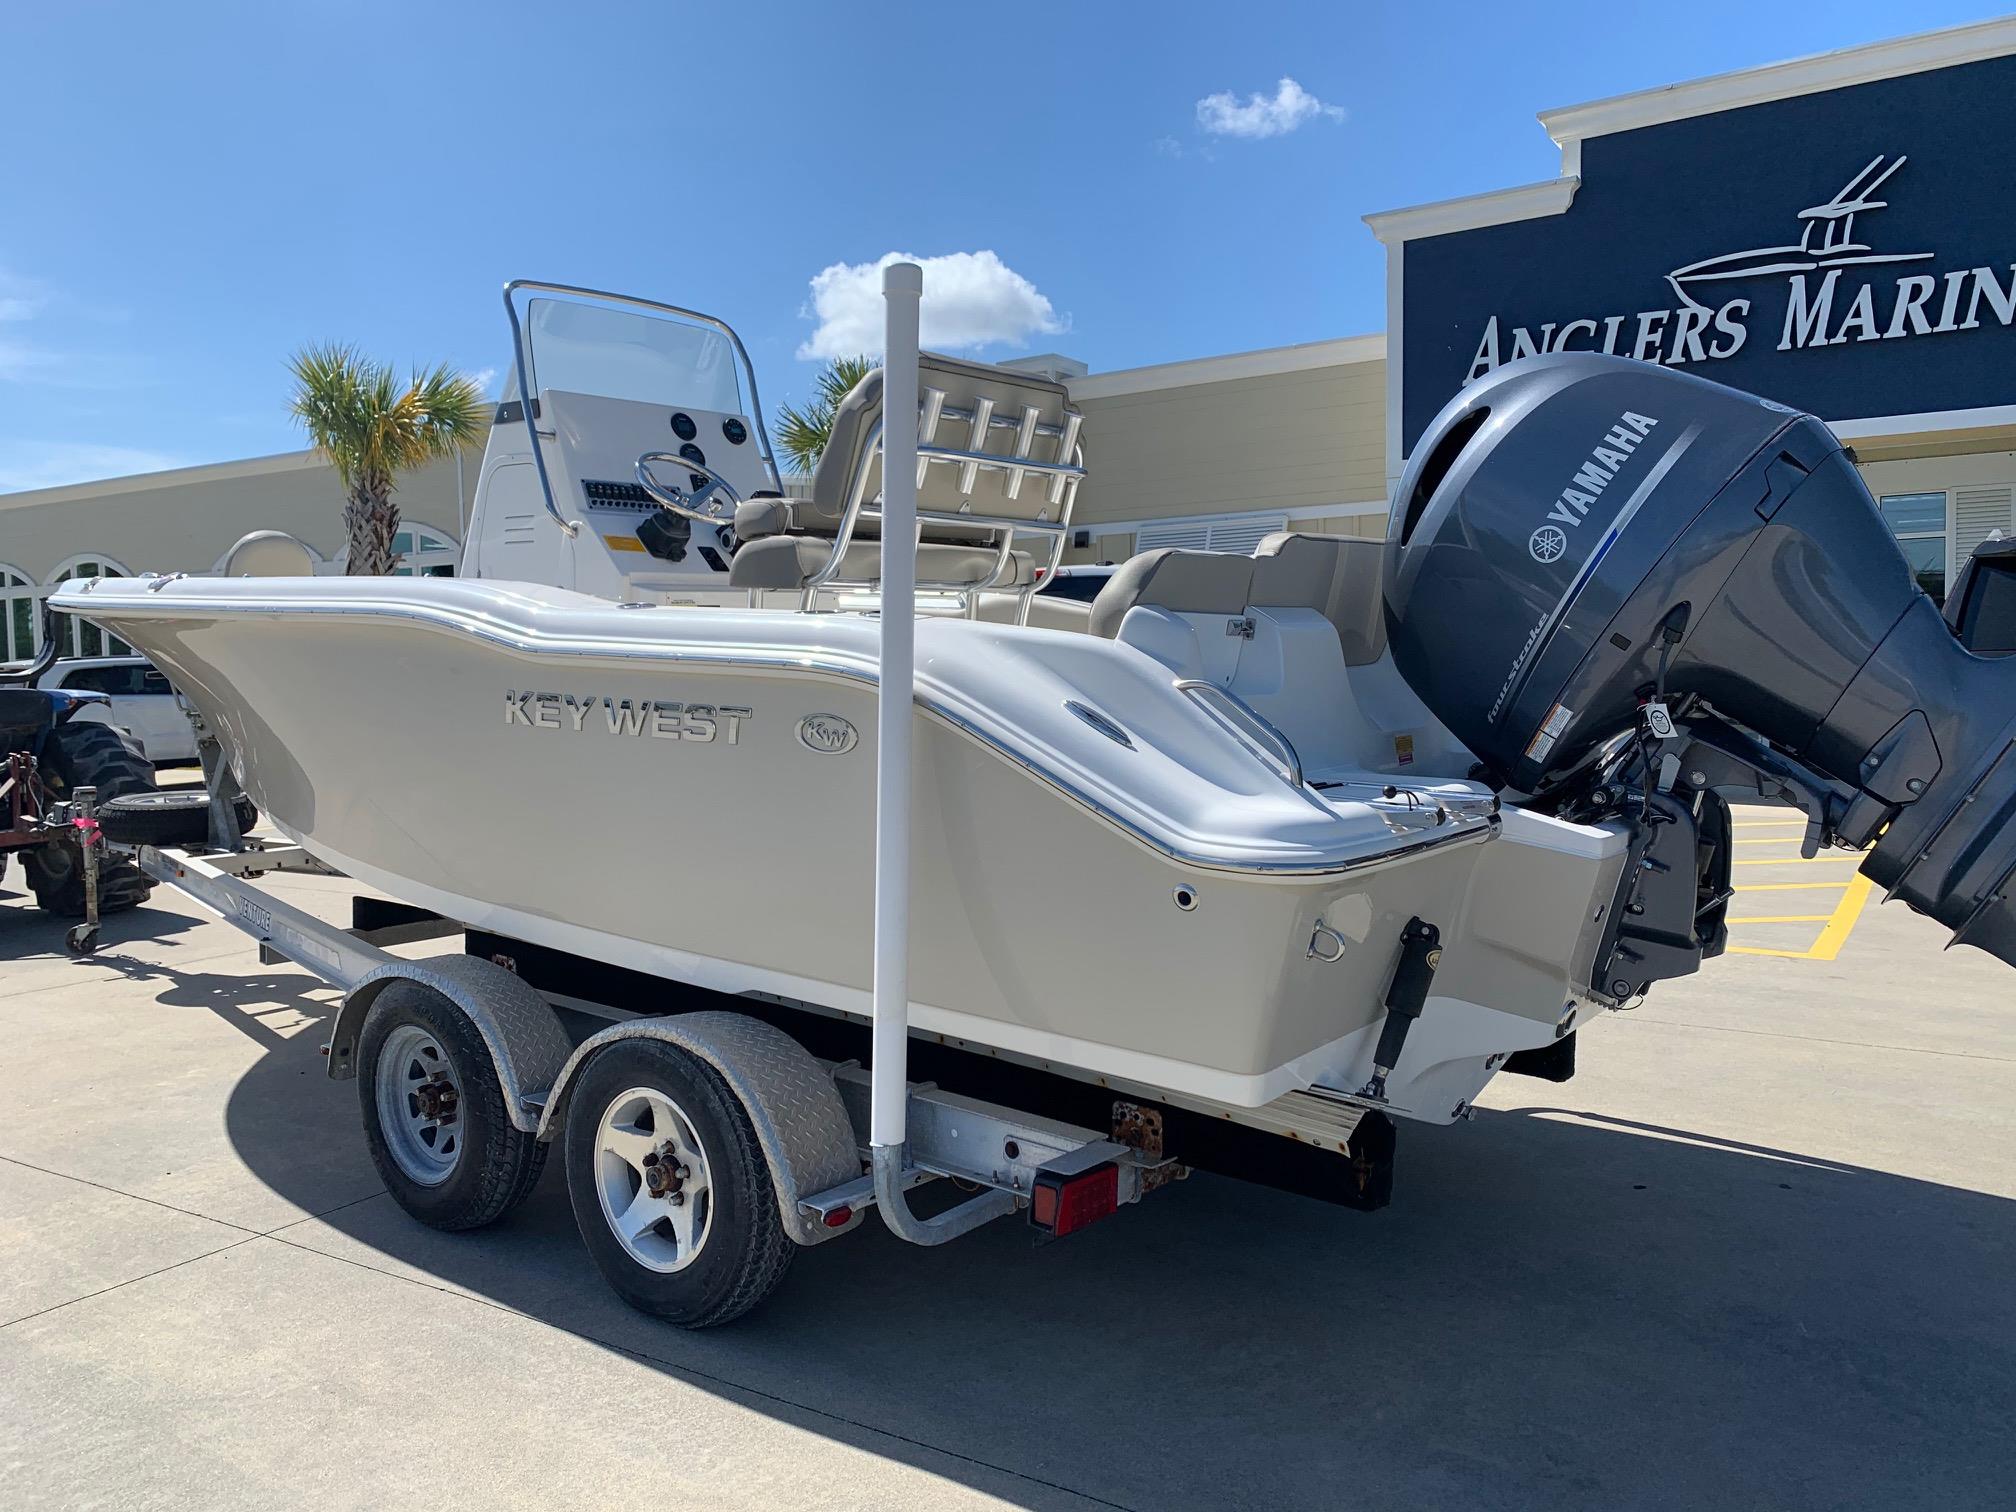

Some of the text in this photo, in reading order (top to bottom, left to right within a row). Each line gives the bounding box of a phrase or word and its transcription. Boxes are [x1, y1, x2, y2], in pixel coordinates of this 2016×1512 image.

[1462, 298, 1751, 387] ANGLERS
[1546, 410, 1659, 528] YAMAHA
[504, 689, 753, 746] KEY WEST
[807, 720, 848, 748] KW
[239, 896, 272, 932] VENTURE
